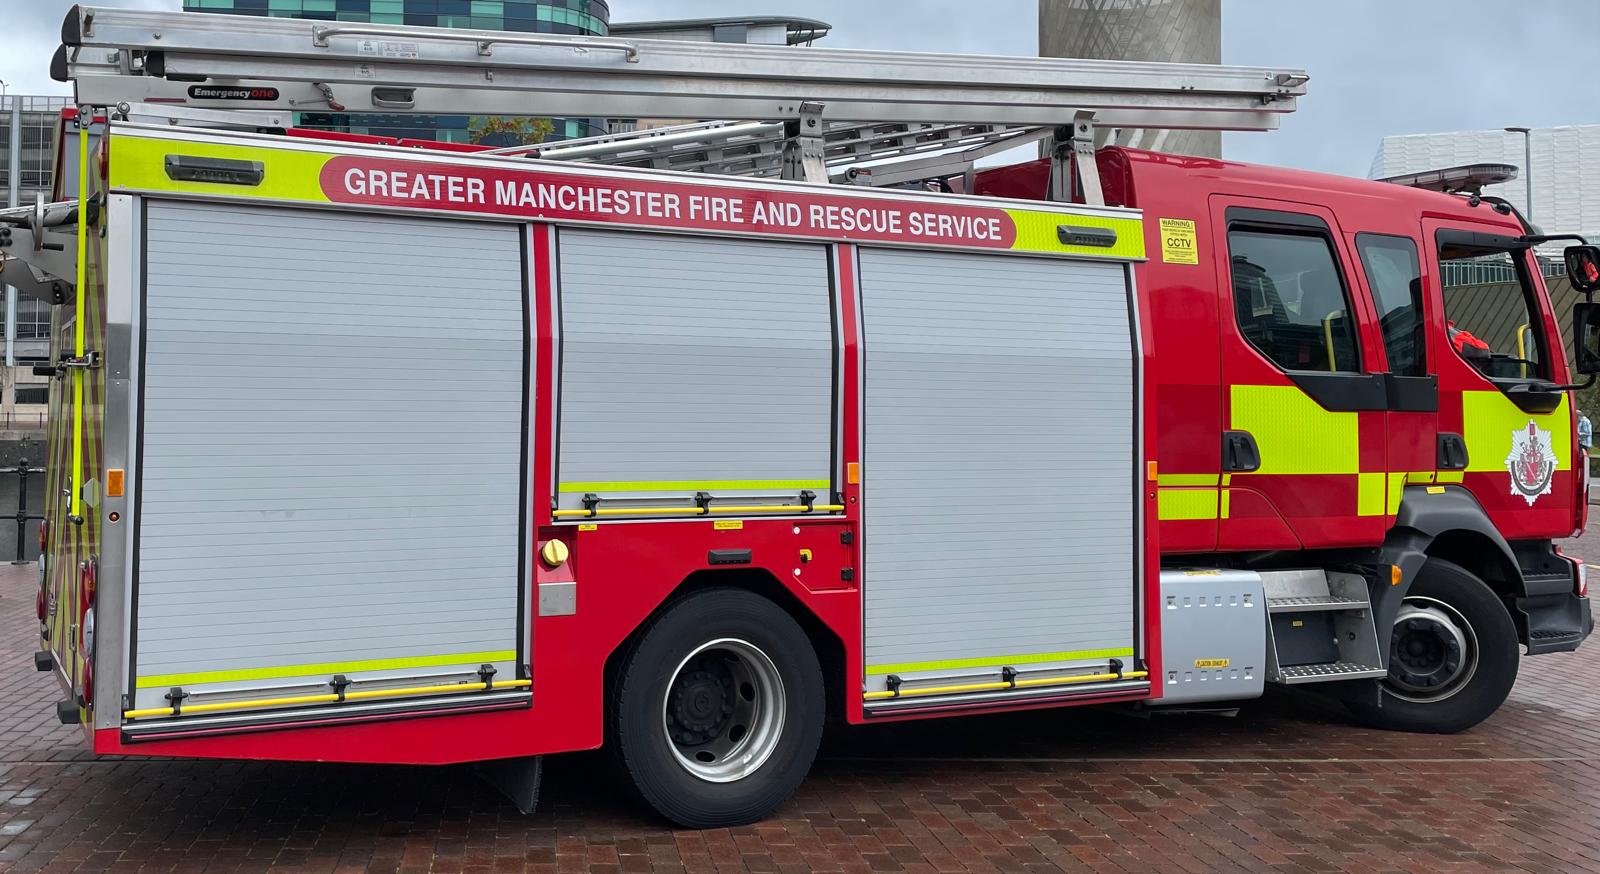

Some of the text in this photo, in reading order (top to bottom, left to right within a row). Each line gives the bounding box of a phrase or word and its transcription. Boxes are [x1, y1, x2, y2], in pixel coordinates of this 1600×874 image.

[344, 168, 1002, 241] GREATER MANCHESTER FIRE AND RESCUE SERVICE
[1167, 238, 1191, 247] CCTV
